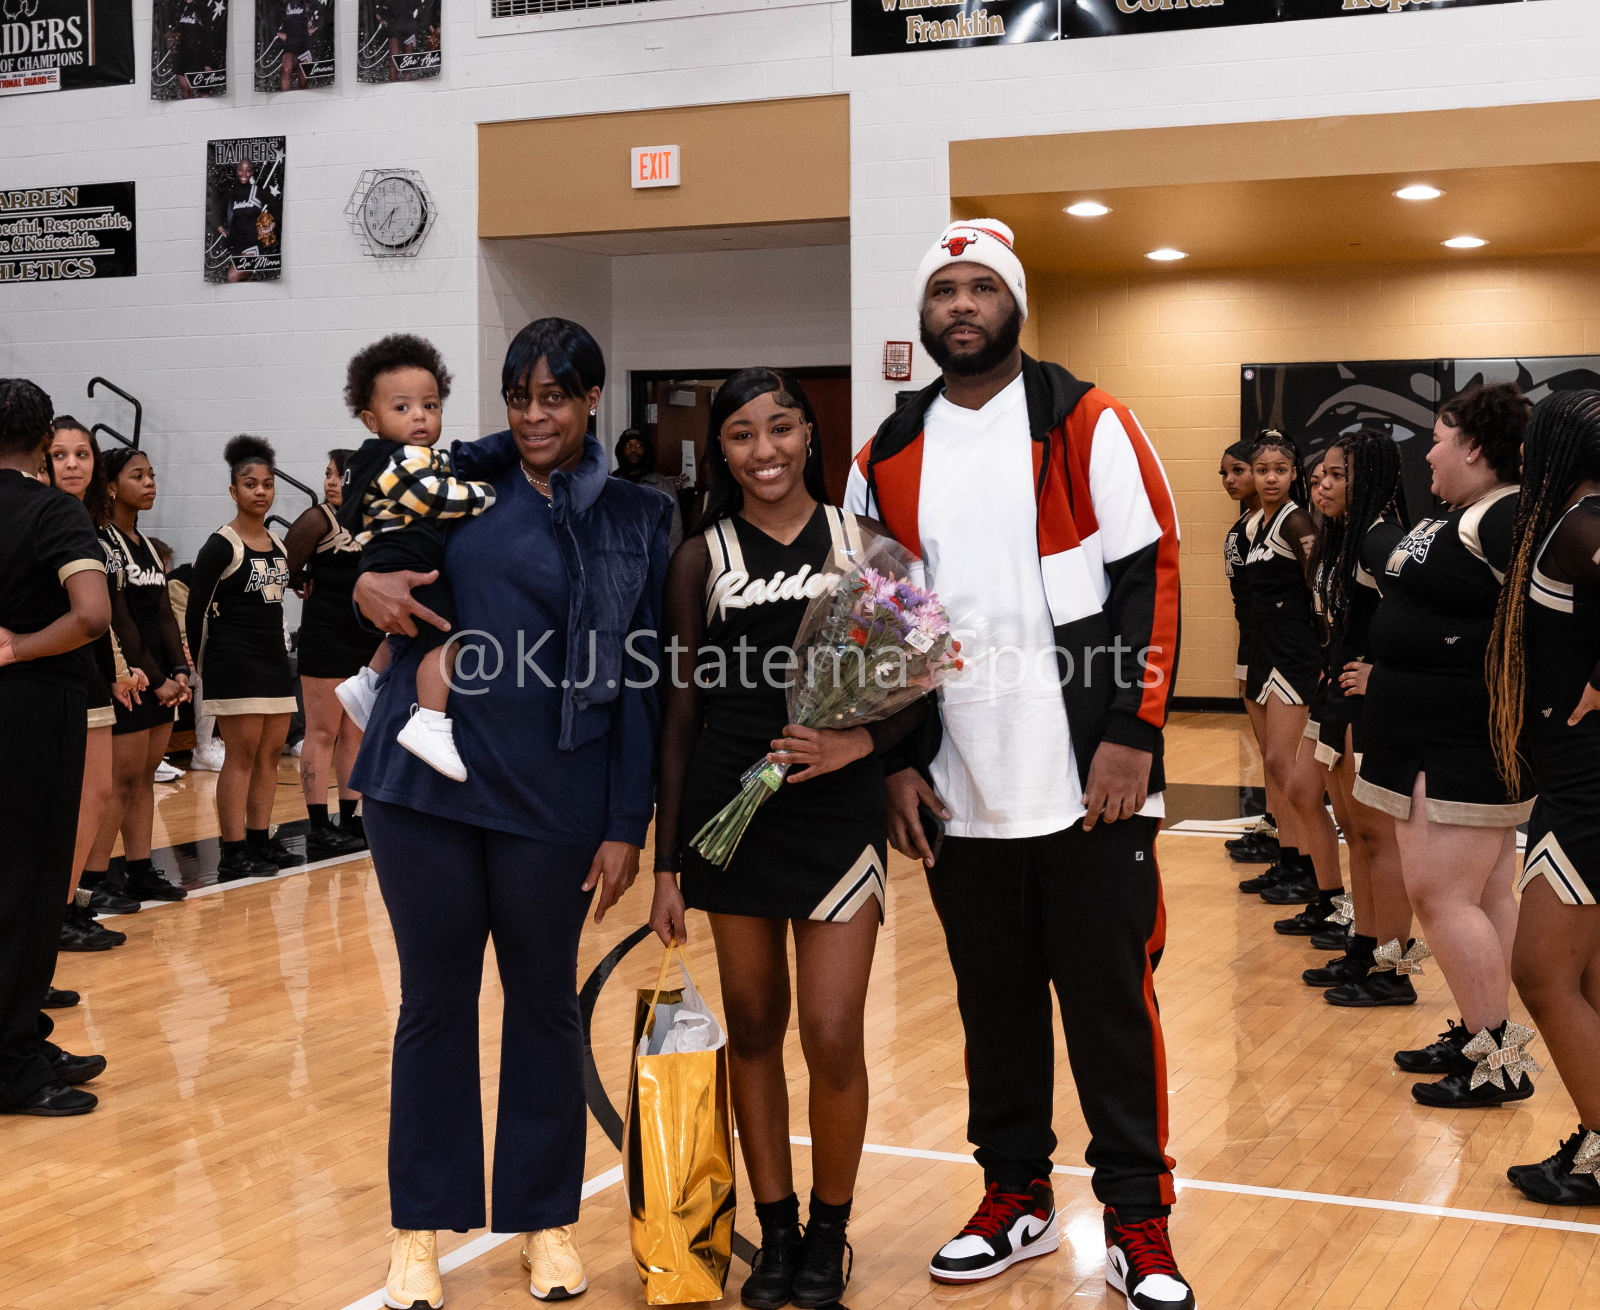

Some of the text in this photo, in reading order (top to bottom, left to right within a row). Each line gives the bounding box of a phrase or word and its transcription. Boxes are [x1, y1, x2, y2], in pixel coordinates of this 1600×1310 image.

[0, 16, 83, 56] IDERS
[906, 9, 1006, 44] Franklin
[0, 50, 83, 73] OF CHAMPIONS
[23, 75, 47, 87] GUARD
[215, 141, 279, 165] RAIDERS
[639, 151, 672, 181] EXIT
[0, 212, 132, 236] ectful, Responsible,
[11, 236, 23, 252] &
[24, 231, 100, 252] Noticeable.
